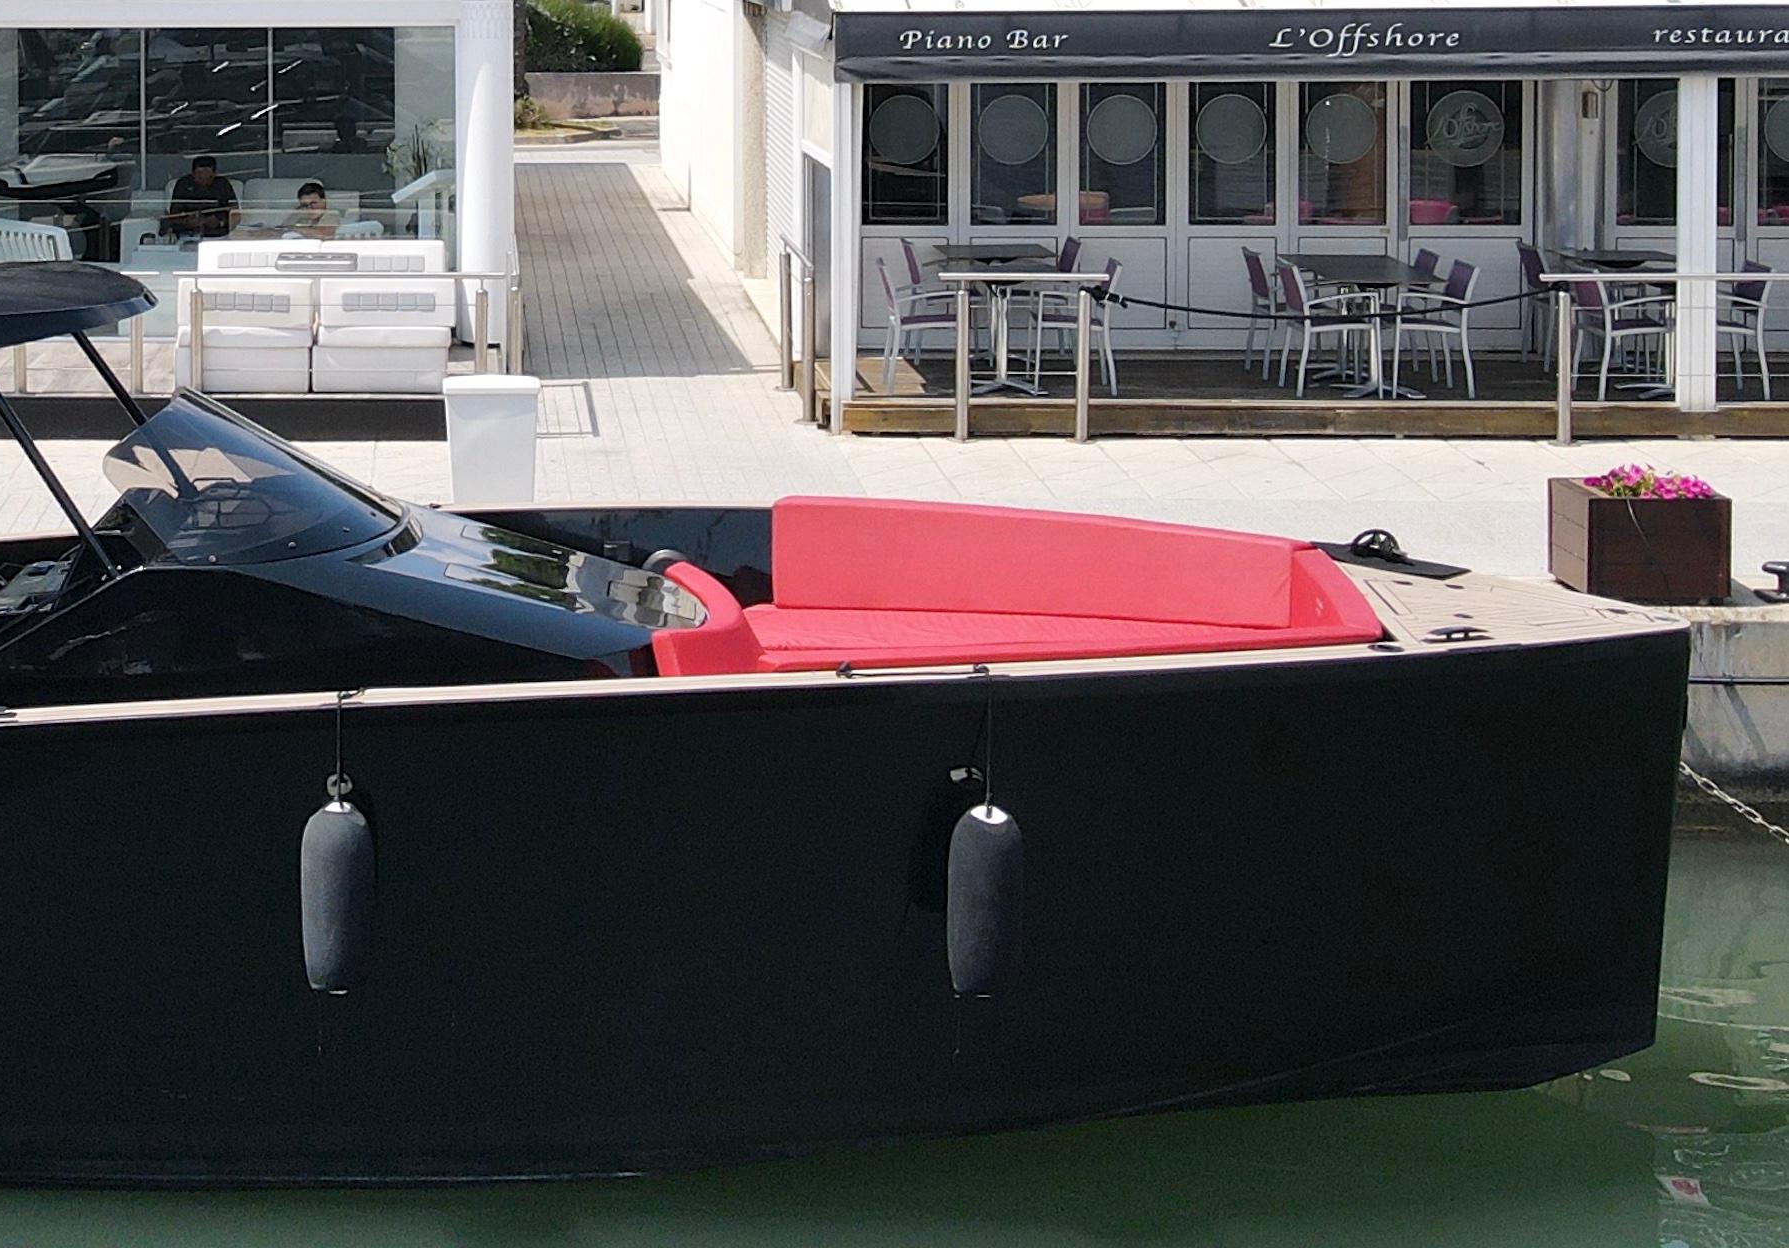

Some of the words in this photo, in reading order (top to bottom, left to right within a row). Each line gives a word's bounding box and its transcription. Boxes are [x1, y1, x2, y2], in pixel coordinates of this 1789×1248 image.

[899, 29, 992, 50] Piano
[1006, 29, 1068, 50] Bar
[1269, 22, 1462, 58] L'Offshore
[1652, 27, 1789, 44] restaura
